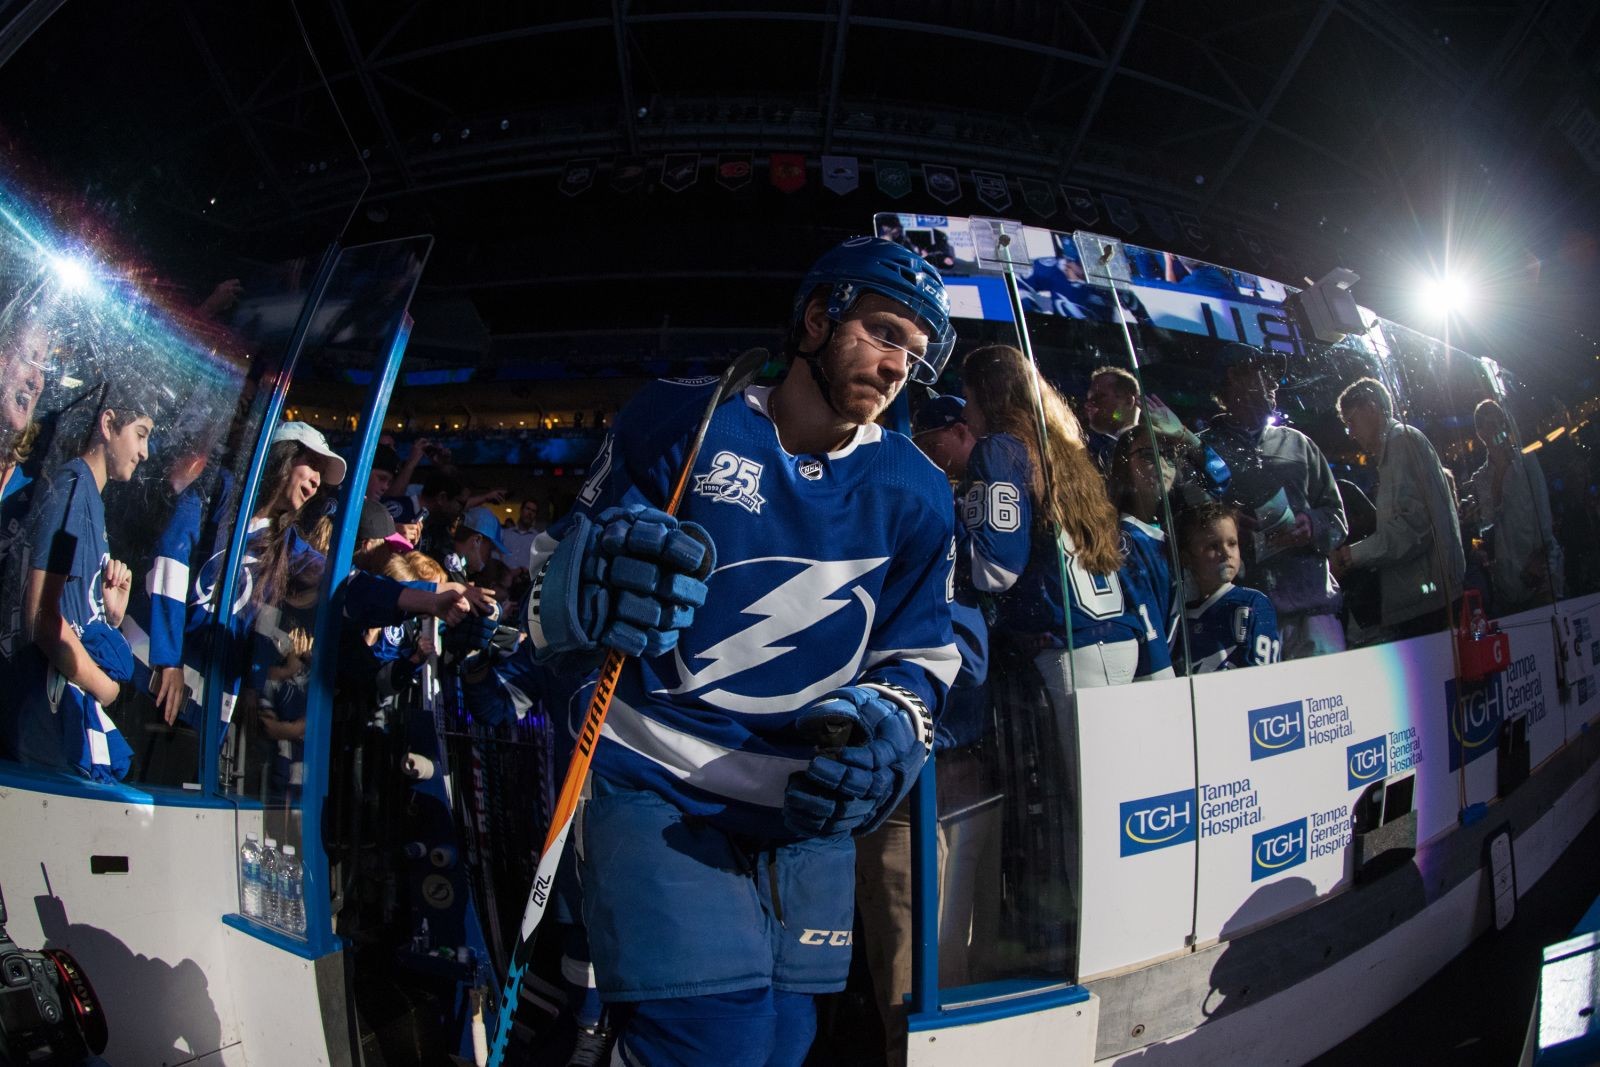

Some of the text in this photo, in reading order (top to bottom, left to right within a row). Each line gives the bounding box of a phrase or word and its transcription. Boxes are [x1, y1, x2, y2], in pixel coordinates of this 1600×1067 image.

[711, 451, 763, 498] 25
[960, 481, 1021, 533] 86
[1234, 606, 1250, 643] C
[1255, 635, 1280, 666] 91
[1493, 640, 1502, 664] G
[1305, 694, 1344, 714] Tampa
[1460, 681, 1500, 733] TGH
[1506, 672, 1542, 712] General
[1259, 711, 1301, 741] TGH
[1307, 706, 1349, 730] General
[1308, 720, 1353, 747] Hospital
[1388, 726, 1417, 746] Tampa
[1389, 737, 1421, 760] General
[1354, 744, 1385, 773] TGH
[1390, 750, 1423, 775] Hospital
[1200, 778, 1251, 802] Tampa
[1134, 801, 1191, 835] TGH
[1200, 790, 1258, 821] General
[1310, 804, 1348, 828] Tampa
[1201, 806, 1262, 839] Hospital
[1262, 828, 1304, 861] TGH
[533, 875, 552, 908] QRL
